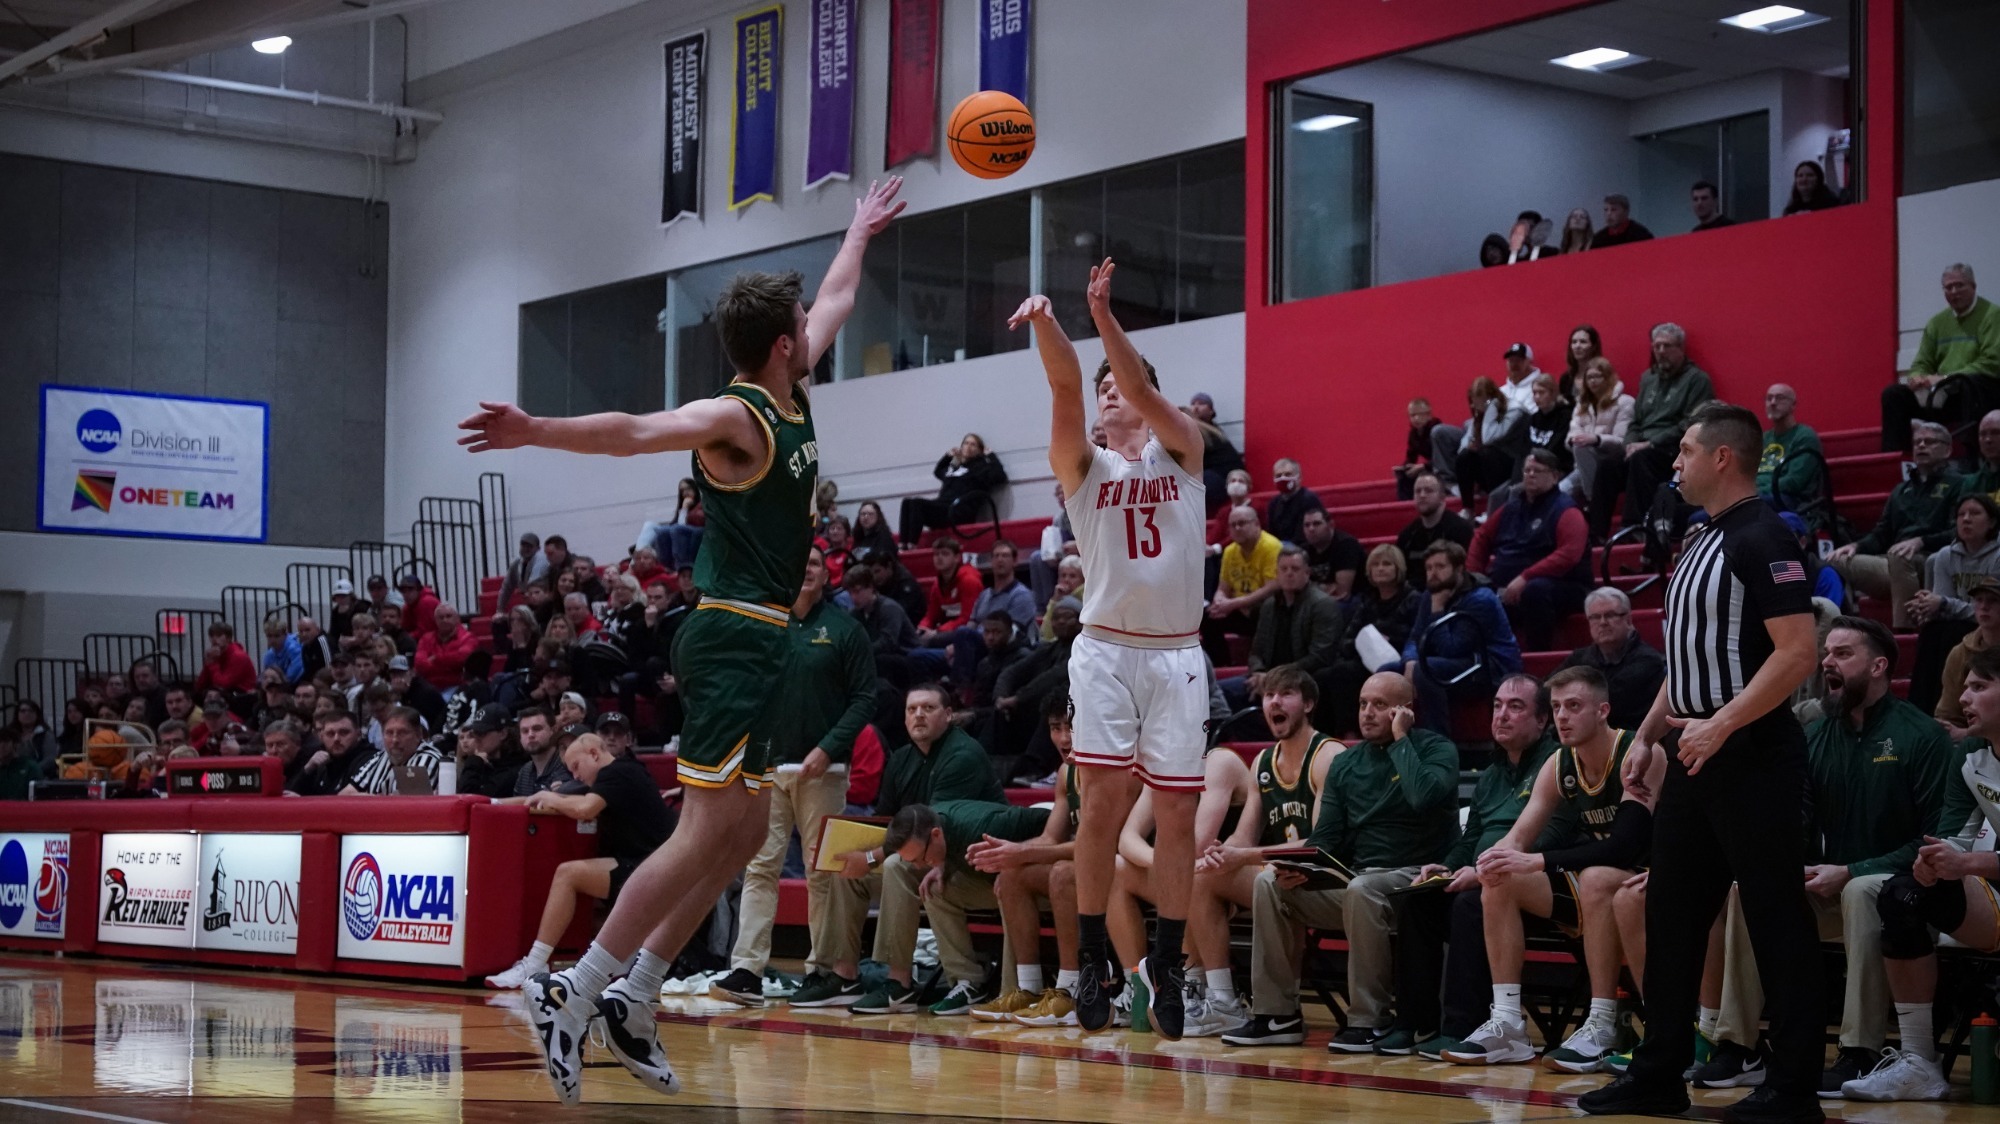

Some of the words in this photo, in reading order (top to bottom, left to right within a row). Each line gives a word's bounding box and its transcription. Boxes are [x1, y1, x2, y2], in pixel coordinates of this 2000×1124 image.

[759, 20, 772, 92] BELOIT
[818, 0, 832, 88] COLLEGE
[745, 23, 758, 112] COLLEGE
[685, 42, 698, 141] MIDWEST
[672, 46, 684, 174] CONFERENCE
[980, 119, 1033, 137] Wilson
[989, 149, 1028, 164] NCAA
[80, 428, 121, 444] NCAA
[131, 429, 202, 452] Division
[208, 435, 220, 453] III
[119, 486, 235, 510] ONETEAM
[1127, 475, 1179, 505] HAWKS
[1122, 506, 1162, 560] 13
[207, 772, 225, 789] POSS
[45, 840, 68, 855] NCAA
[117, 850, 145, 864] HOME
[149, 852, 161, 864] OF
[166, 852, 182, 865] THE
[0, 882, 27, 908] NCAA
[128, 888, 153, 898] RIPON
[155, 889, 192, 900] COLLEGE
[233, 879, 300, 925] RIPON
[384, 874, 454, 921] NCAA
[243, 928, 286, 943] COLLEGE
[381, 922, 450, 943] VOLLEYBALL
